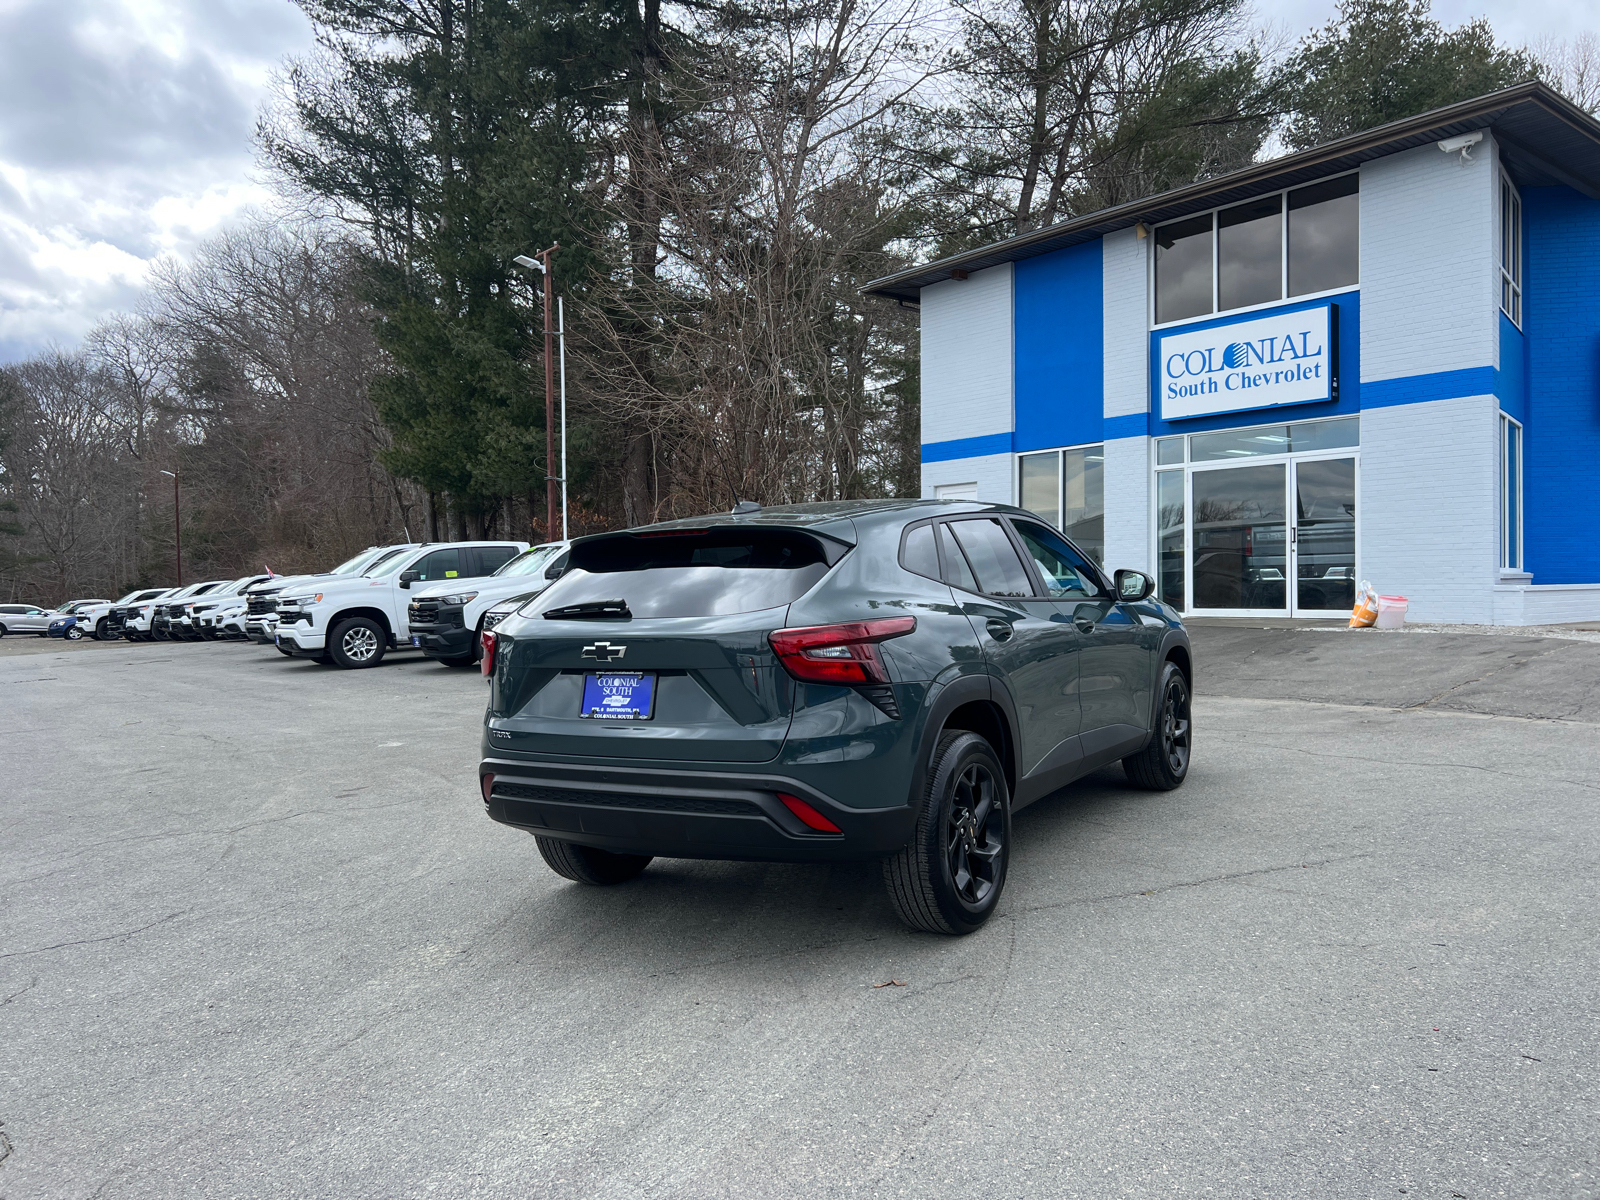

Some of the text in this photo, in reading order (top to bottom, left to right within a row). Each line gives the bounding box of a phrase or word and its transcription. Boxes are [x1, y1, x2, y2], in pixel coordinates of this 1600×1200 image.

[1166, 331, 1322, 379] COLONIAL
[1167, 362, 1322, 400] South Chevrolet
[597, 678, 640, 687] COLONIAL
[602, 687, 633, 696] SOUTH
